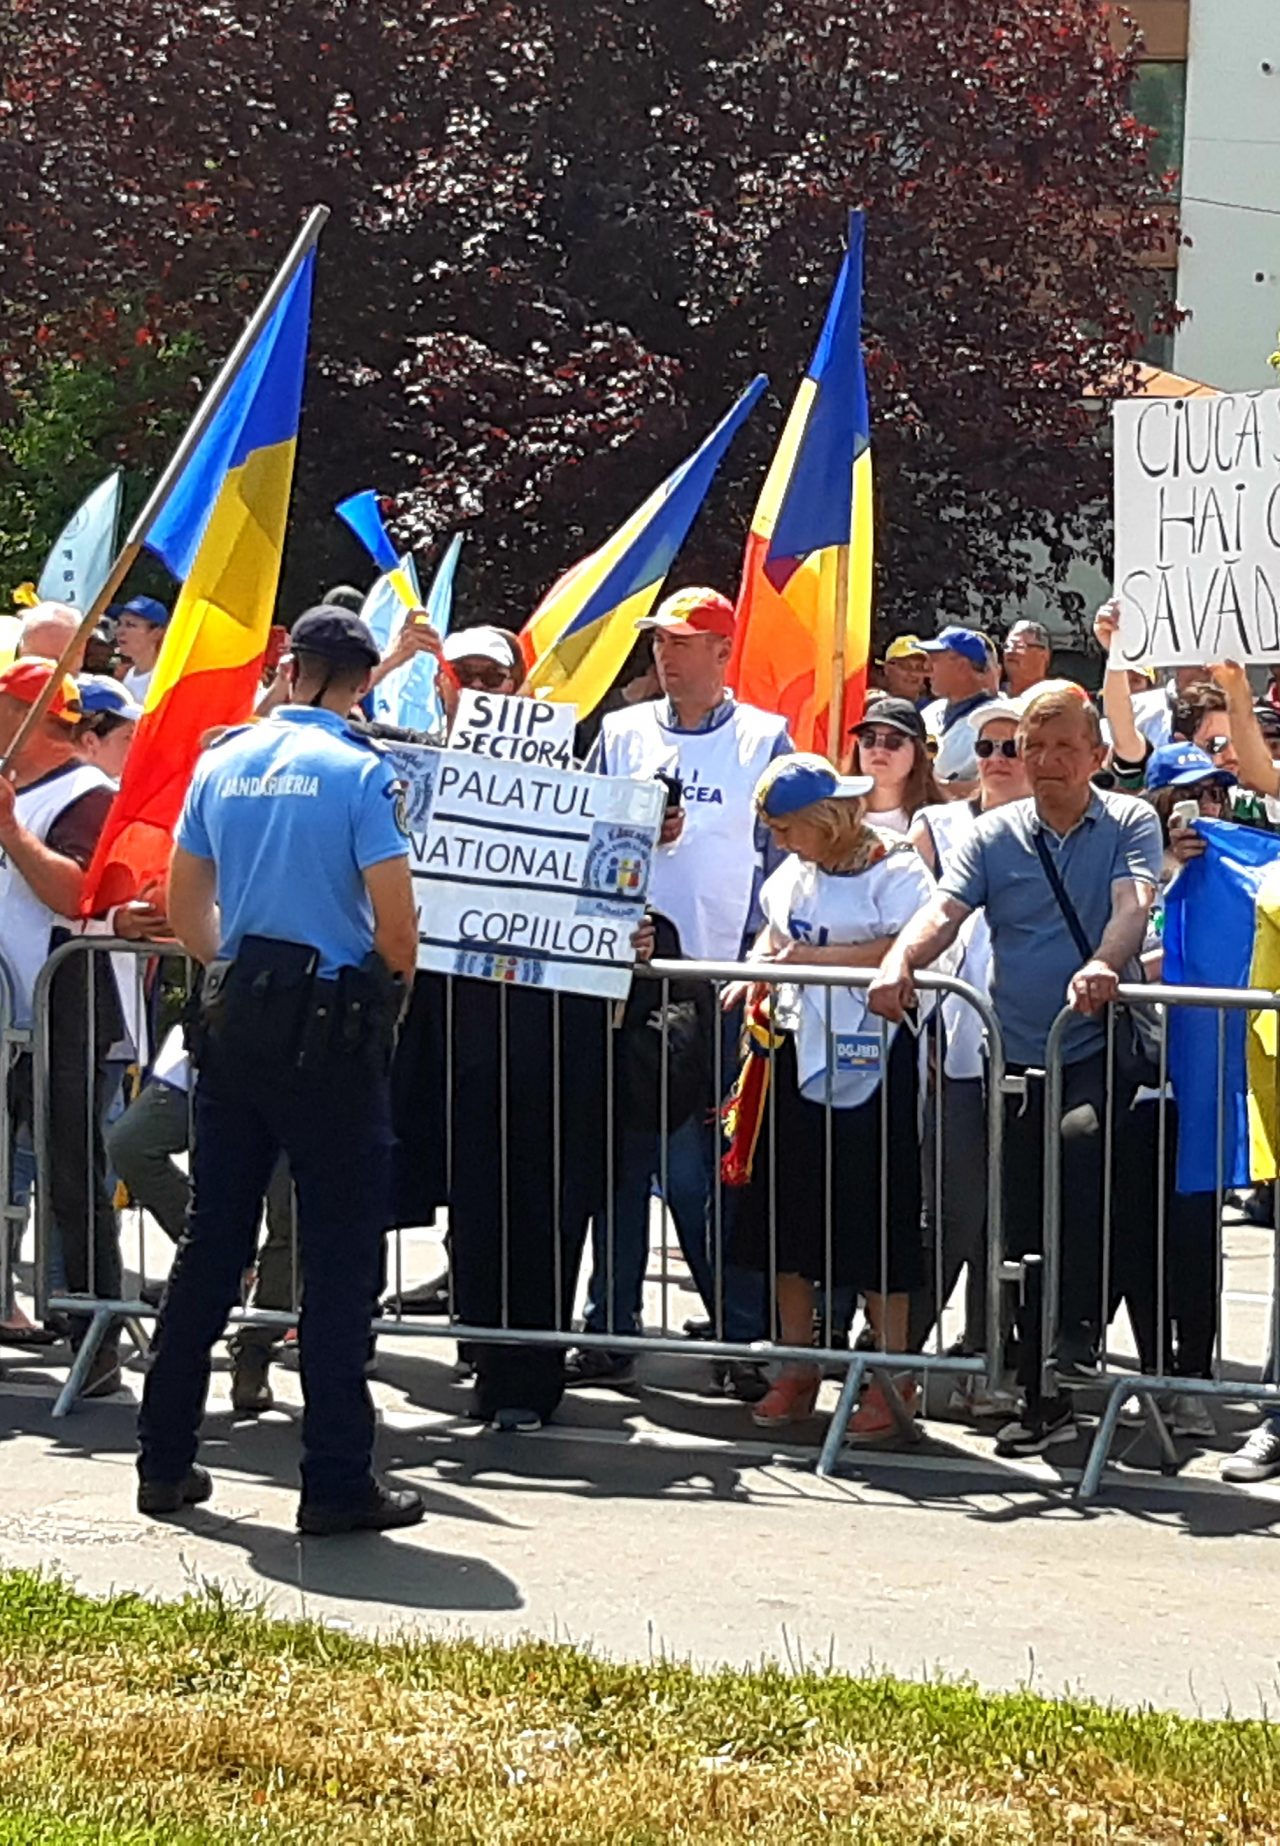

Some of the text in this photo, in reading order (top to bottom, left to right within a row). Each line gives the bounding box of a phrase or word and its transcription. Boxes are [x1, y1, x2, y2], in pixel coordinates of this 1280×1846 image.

[468, 695, 555, 737] SIIP
[438, 766, 596, 818] PALATUL
[409, 831, 578, 882] NATIONAL
[458, 909, 619, 960] COPIILOR
